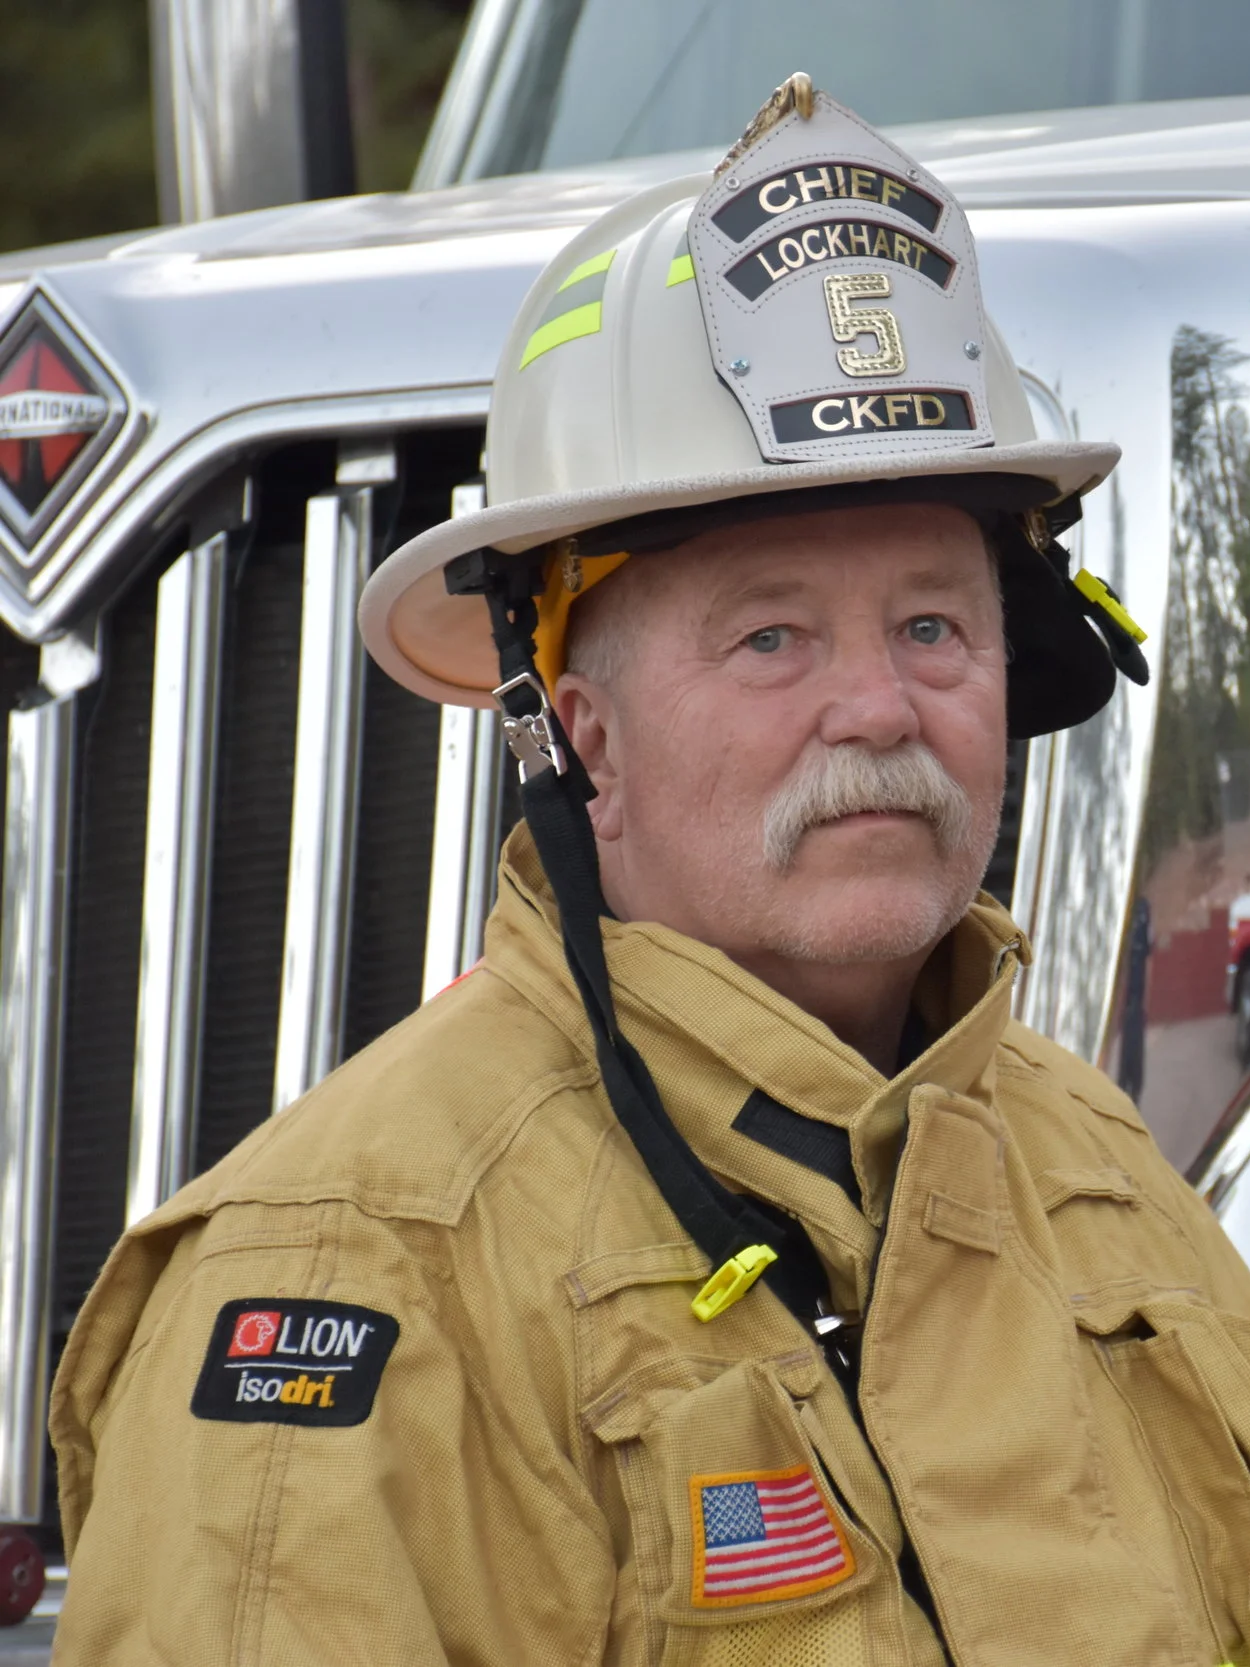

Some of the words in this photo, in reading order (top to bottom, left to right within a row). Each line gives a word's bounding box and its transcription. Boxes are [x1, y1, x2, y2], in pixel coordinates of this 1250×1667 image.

[758, 165, 906, 214] CHIEF
[757, 224, 927, 281] LOCKHART
[823, 273, 907, 377] 5
[812, 393, 946, 432] CKFD
[275, 1315, 367, 1357] LION
